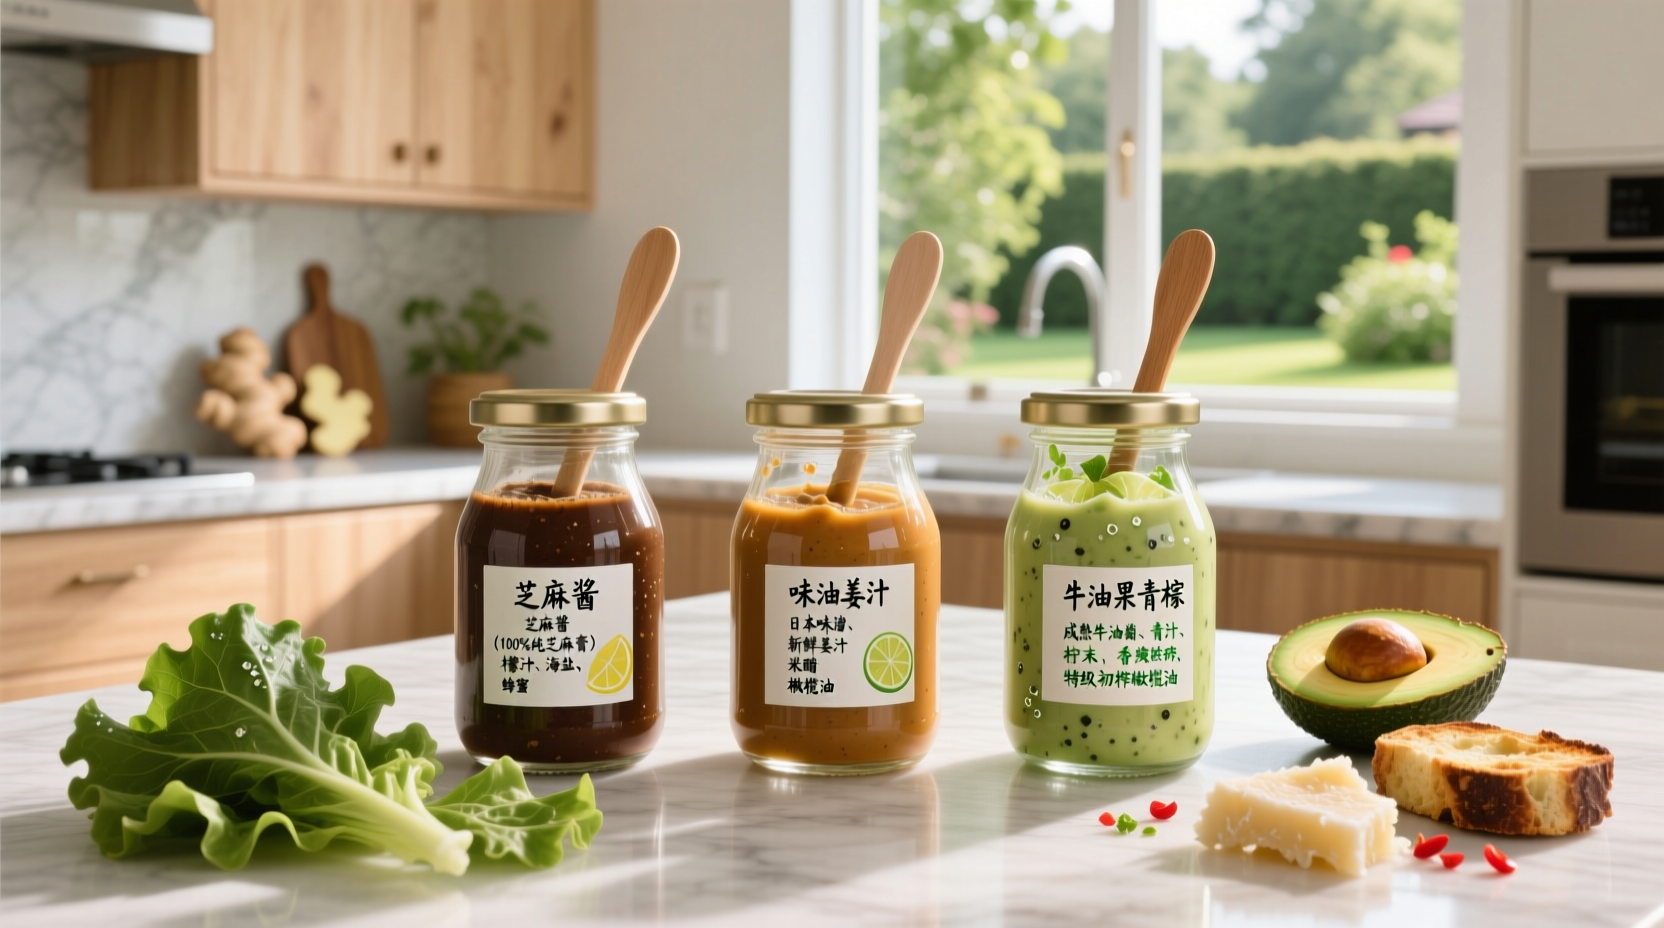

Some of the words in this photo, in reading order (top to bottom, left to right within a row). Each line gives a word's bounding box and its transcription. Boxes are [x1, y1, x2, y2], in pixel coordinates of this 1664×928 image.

[514, 577, 599, 611] 芝麻酱
[789, 577, 890, 609] 味油姜汁
